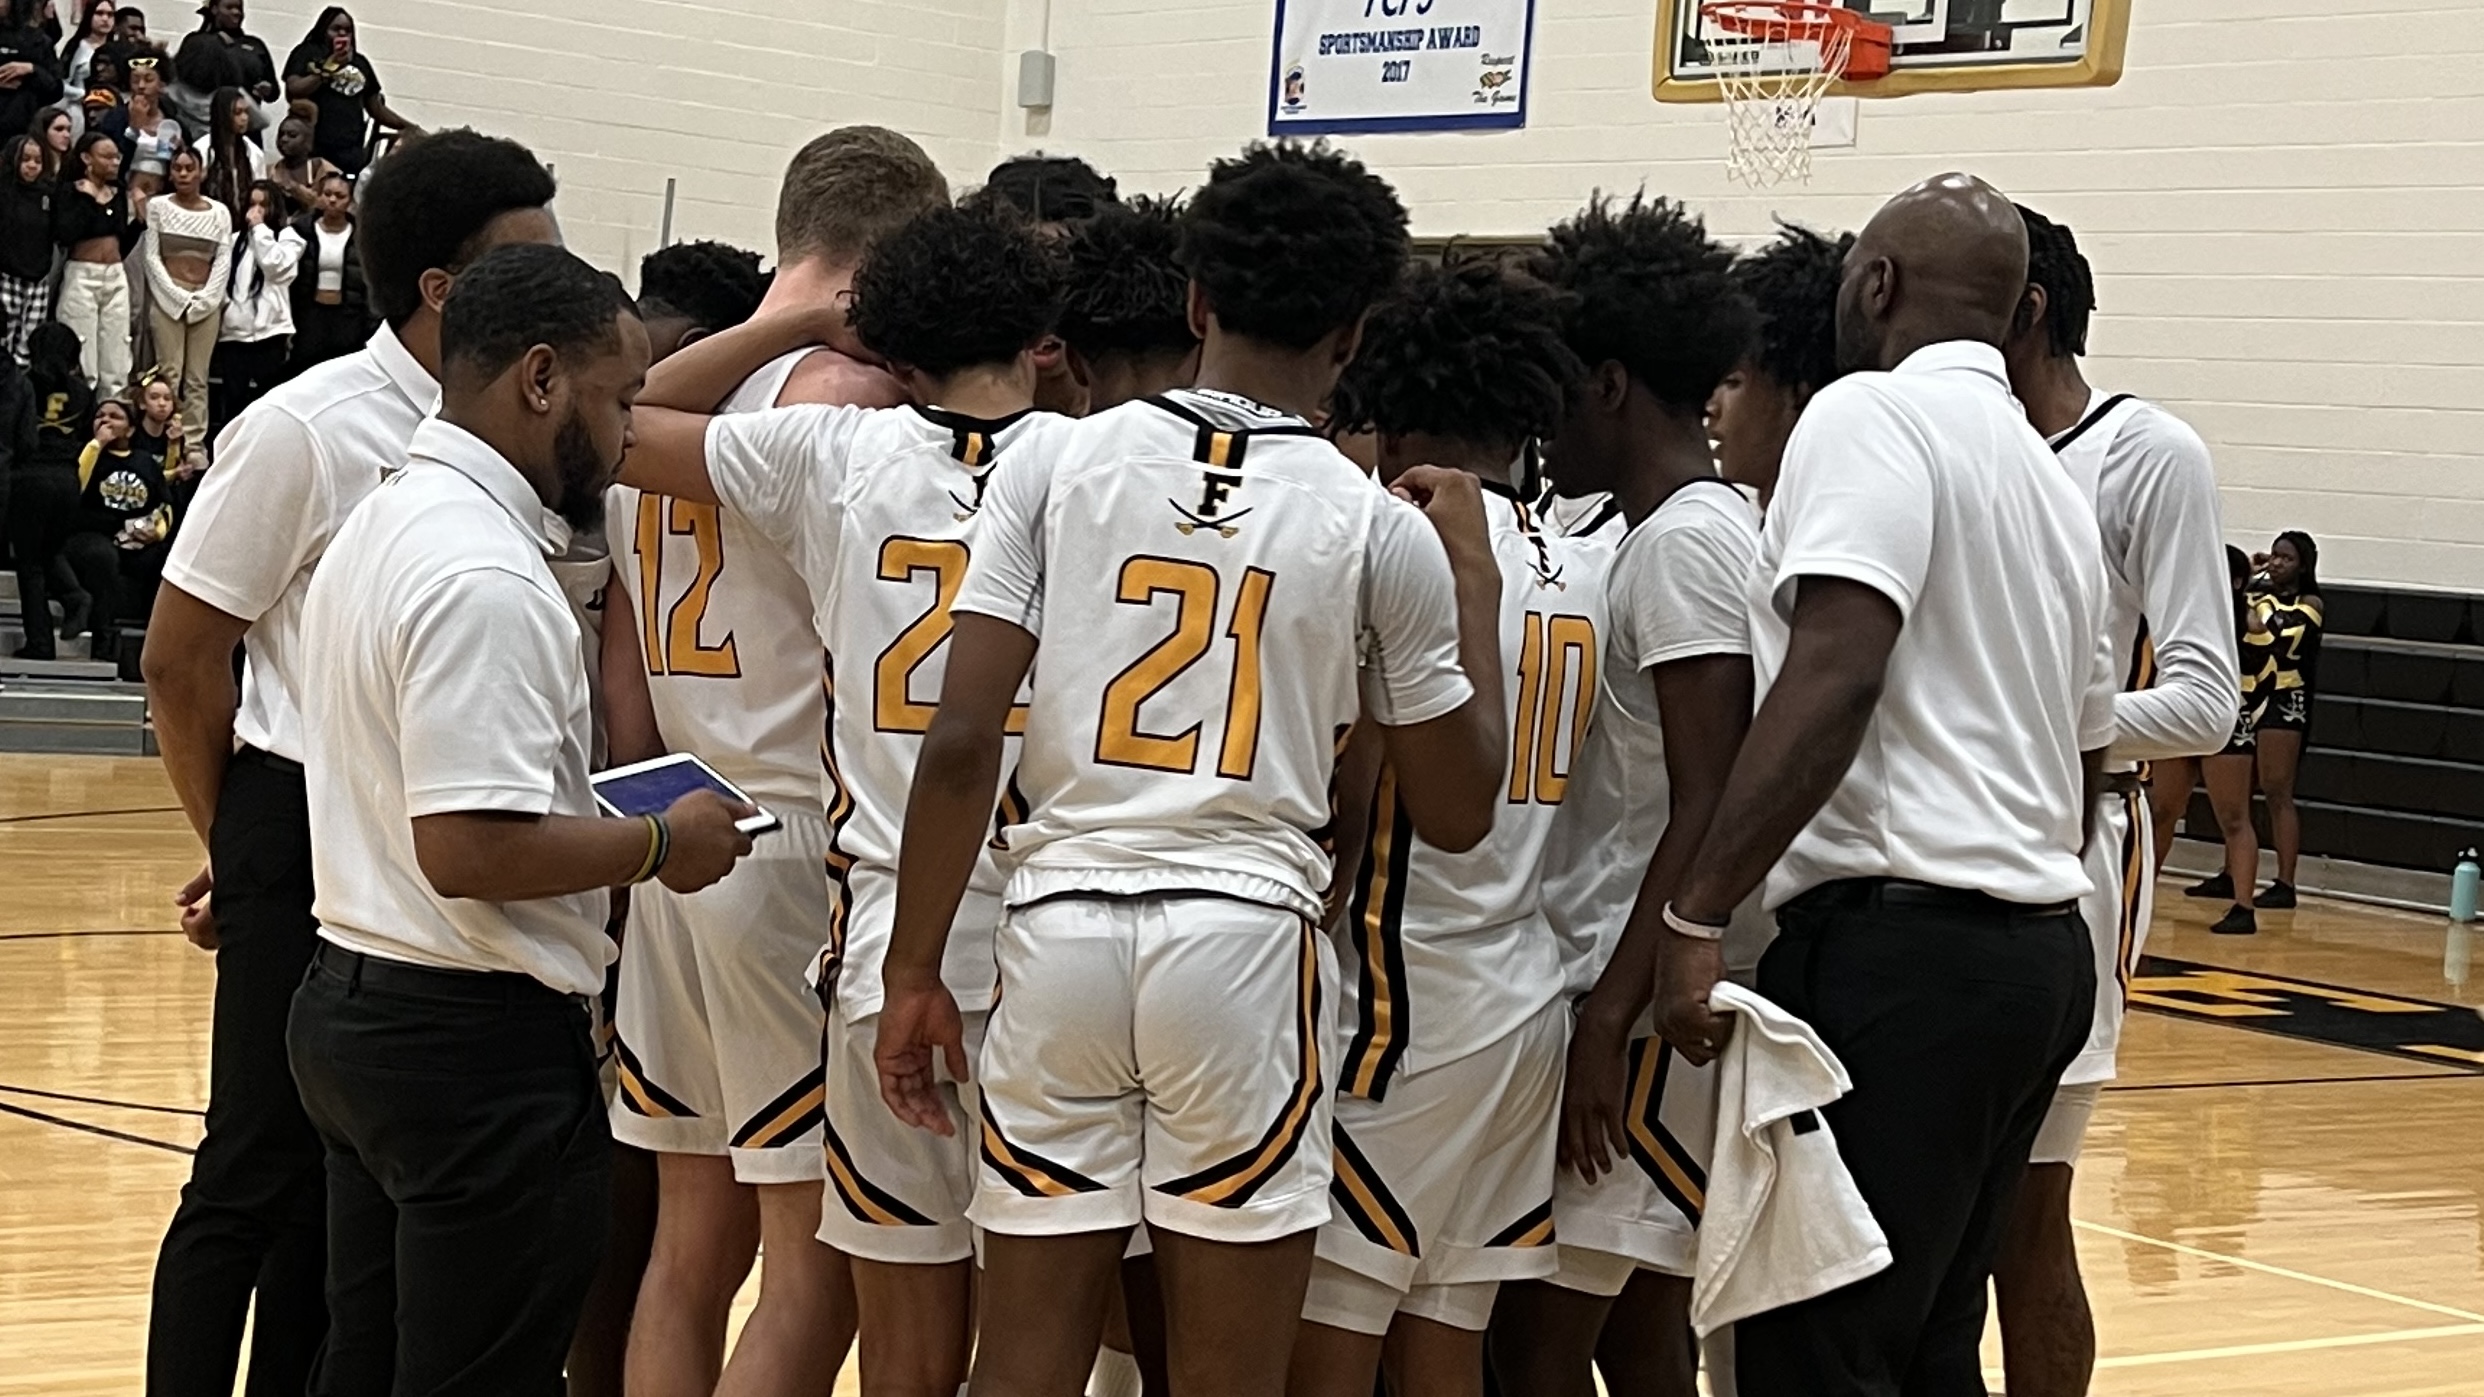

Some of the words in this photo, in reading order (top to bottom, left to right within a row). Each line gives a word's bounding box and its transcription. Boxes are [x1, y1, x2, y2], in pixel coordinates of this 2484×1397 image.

[1318, 29, 1424, 55] SPORTSMANSHIP
[1426, 25, 1481, 50] AWARD
[1381, 60, 1411, 82] 2017
[1472, 90, 1488, 104] The
[1490, 90, 1517, 107] Game
[1197, 471, 1244, 517] F
[633, 493, 742, 678] 12
[1094, 553, 1276, 782] 21
[1508, 610, 1597, 805] 10
